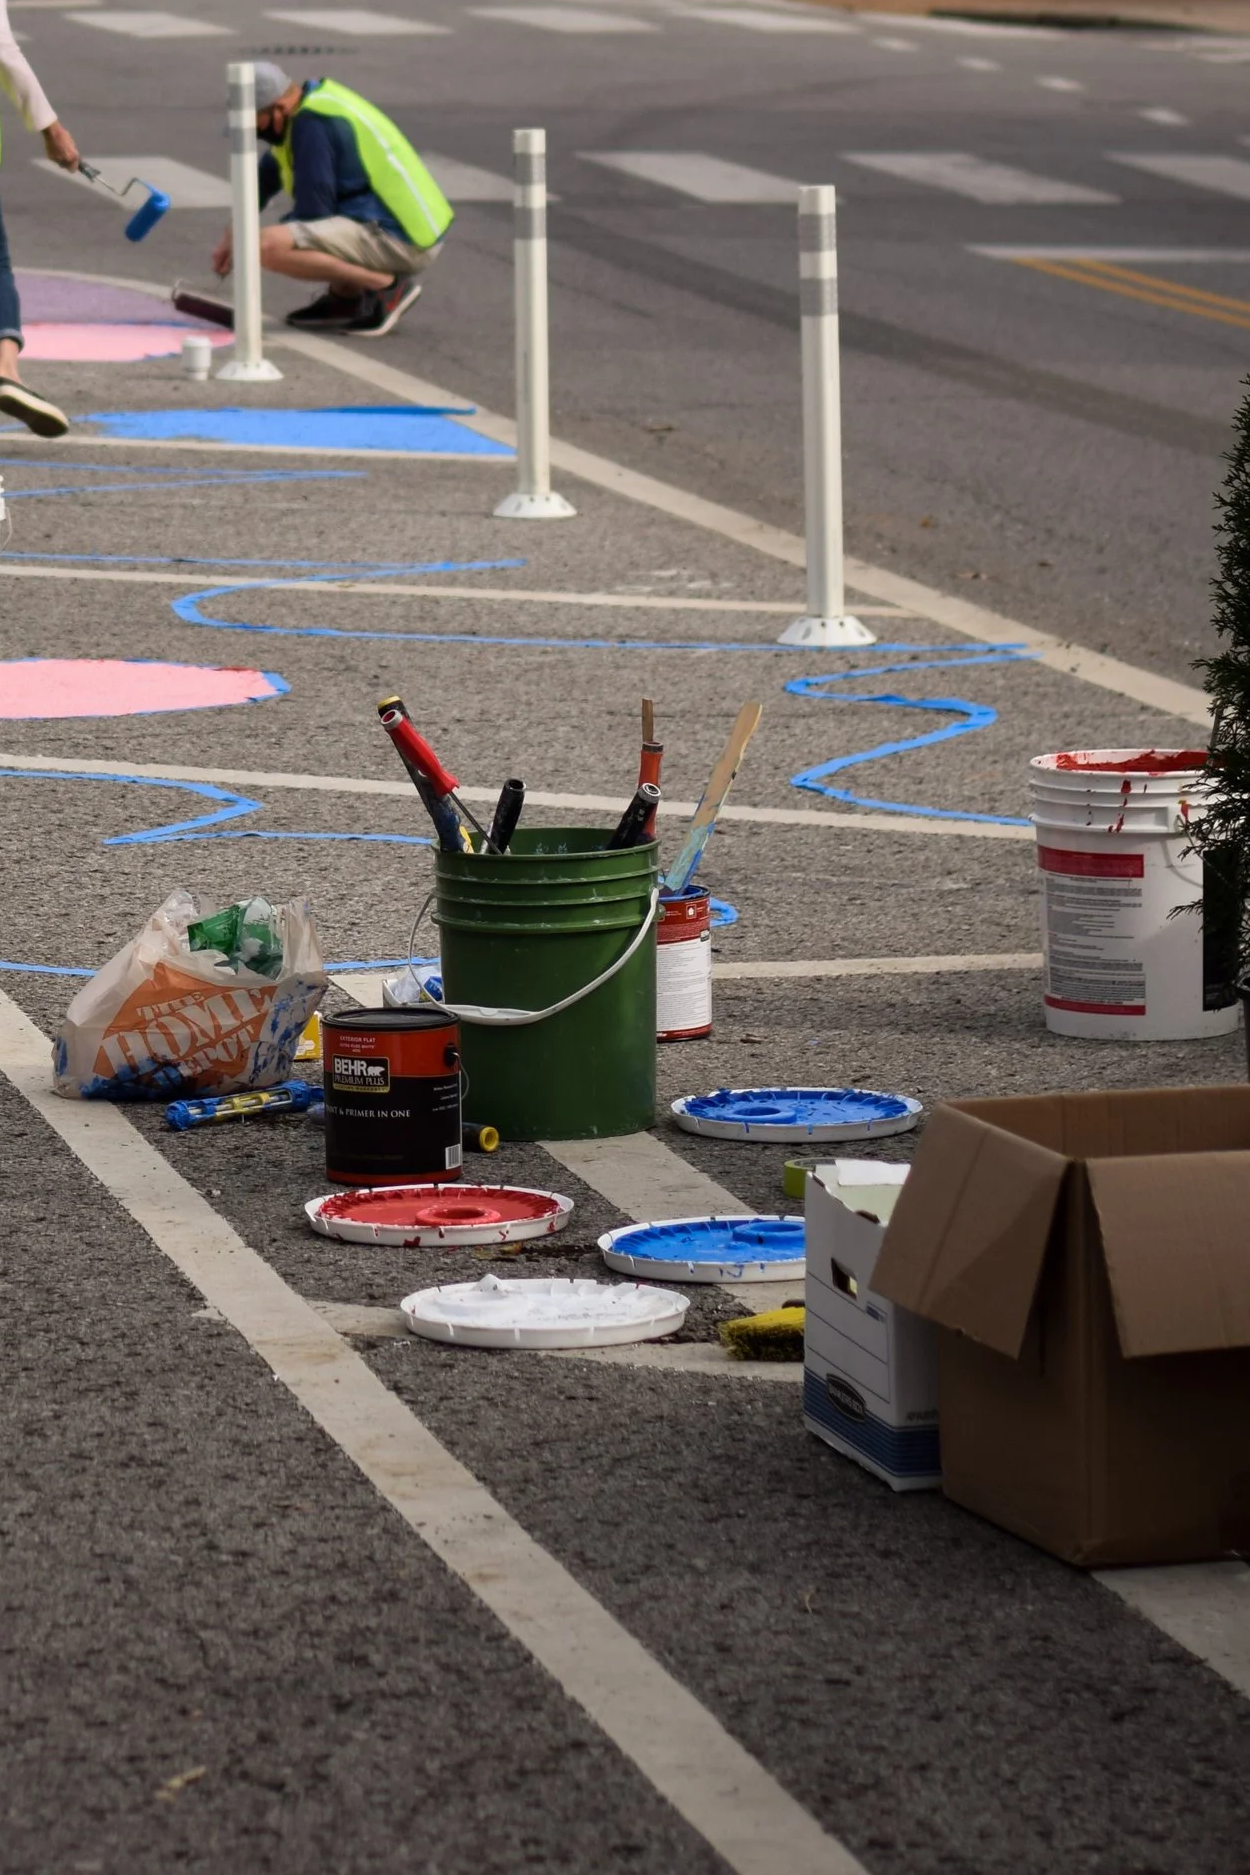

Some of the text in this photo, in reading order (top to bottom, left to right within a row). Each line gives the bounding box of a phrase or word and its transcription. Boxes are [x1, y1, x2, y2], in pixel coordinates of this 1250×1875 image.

[137, 992, 205, 1021] THE
[102, 989, 273, 1079] HOME
[334, 1057, 367, 1076] BEHR
[334, 1075, 385, 1086] PREMIUM PLUS
[345, 1108, 375, 1117] PRIMER
[377, 1110, 388, 1118] IN
[390, 1109, 411, 1118] ONE
